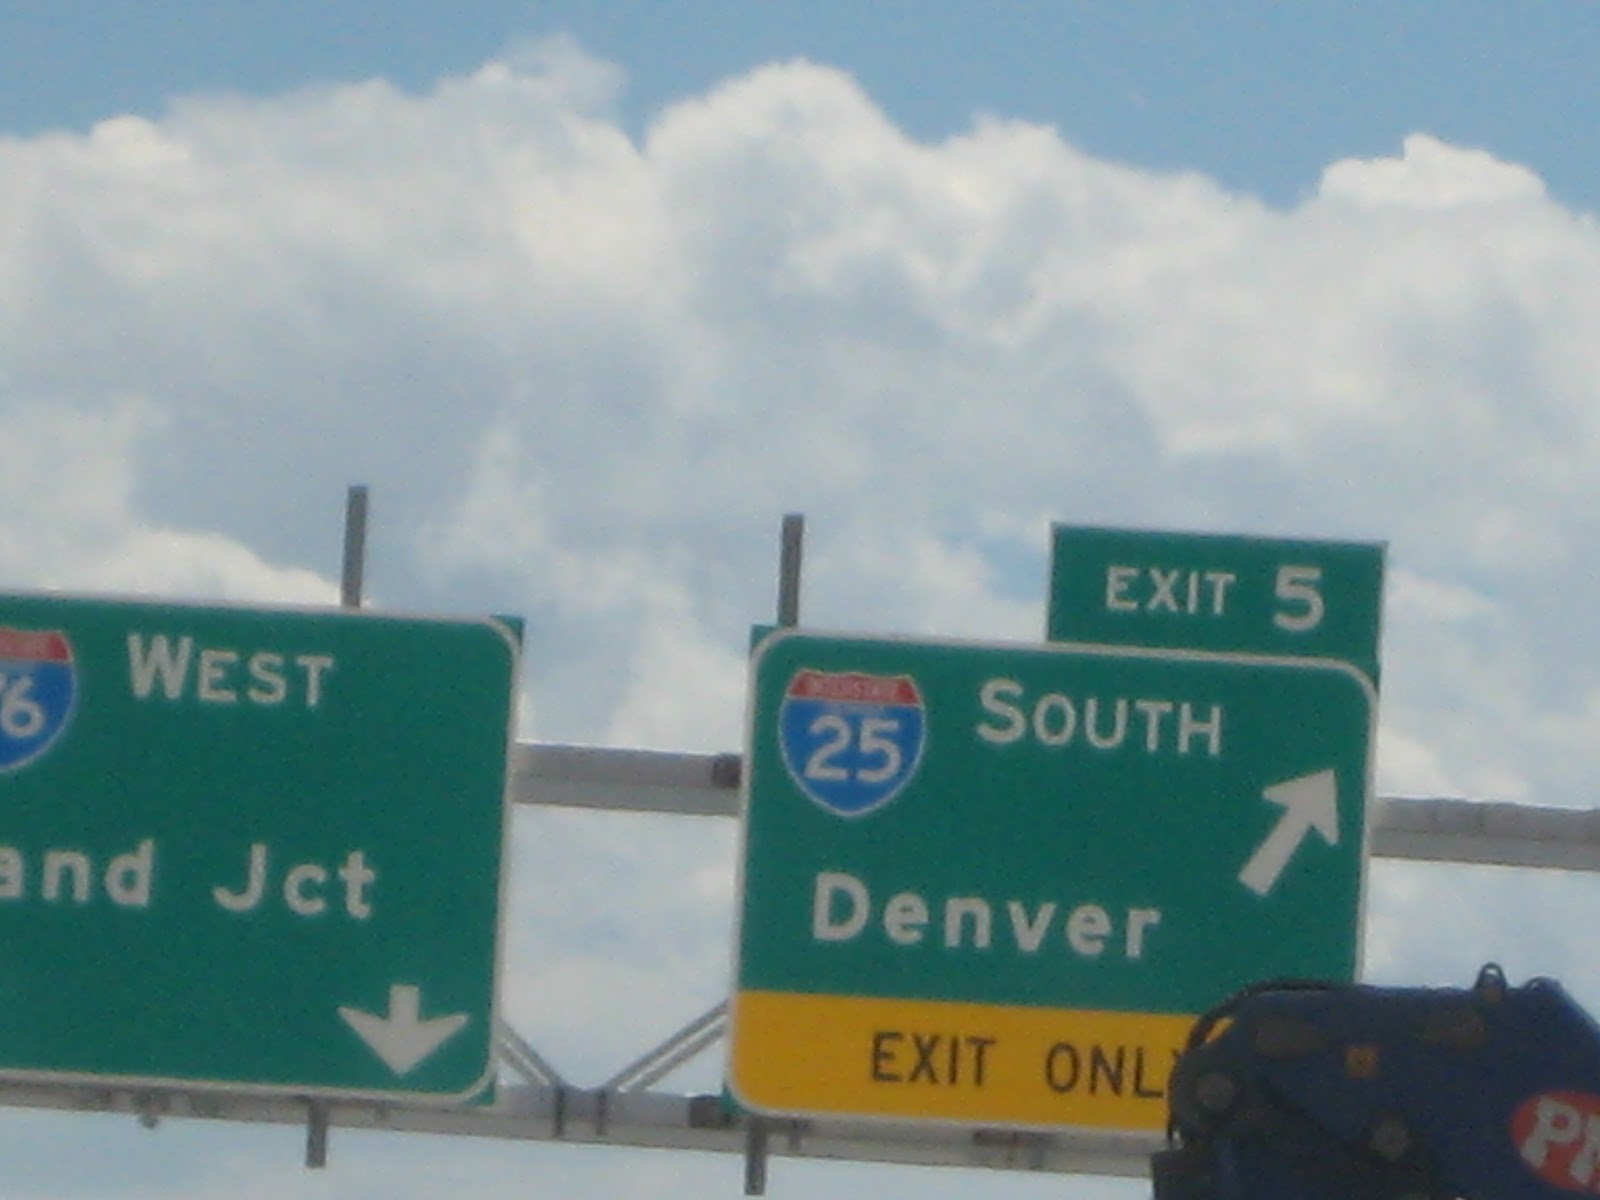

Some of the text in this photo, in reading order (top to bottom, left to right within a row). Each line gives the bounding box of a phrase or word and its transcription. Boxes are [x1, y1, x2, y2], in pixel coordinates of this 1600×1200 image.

[1105, 565, 1325, 632] EXIT 5
[0, 671, 45, 738] 6
[126, 633, 335, 706] WEST
[804, 713, 902, 784] 25
[976, 677, 1222, 756] SOUTH
[212, 843, 376, 920] Jct
[812, 871, 1161, 959] Denver
[870, 1030, 1181, 1101] EXIT ONL
